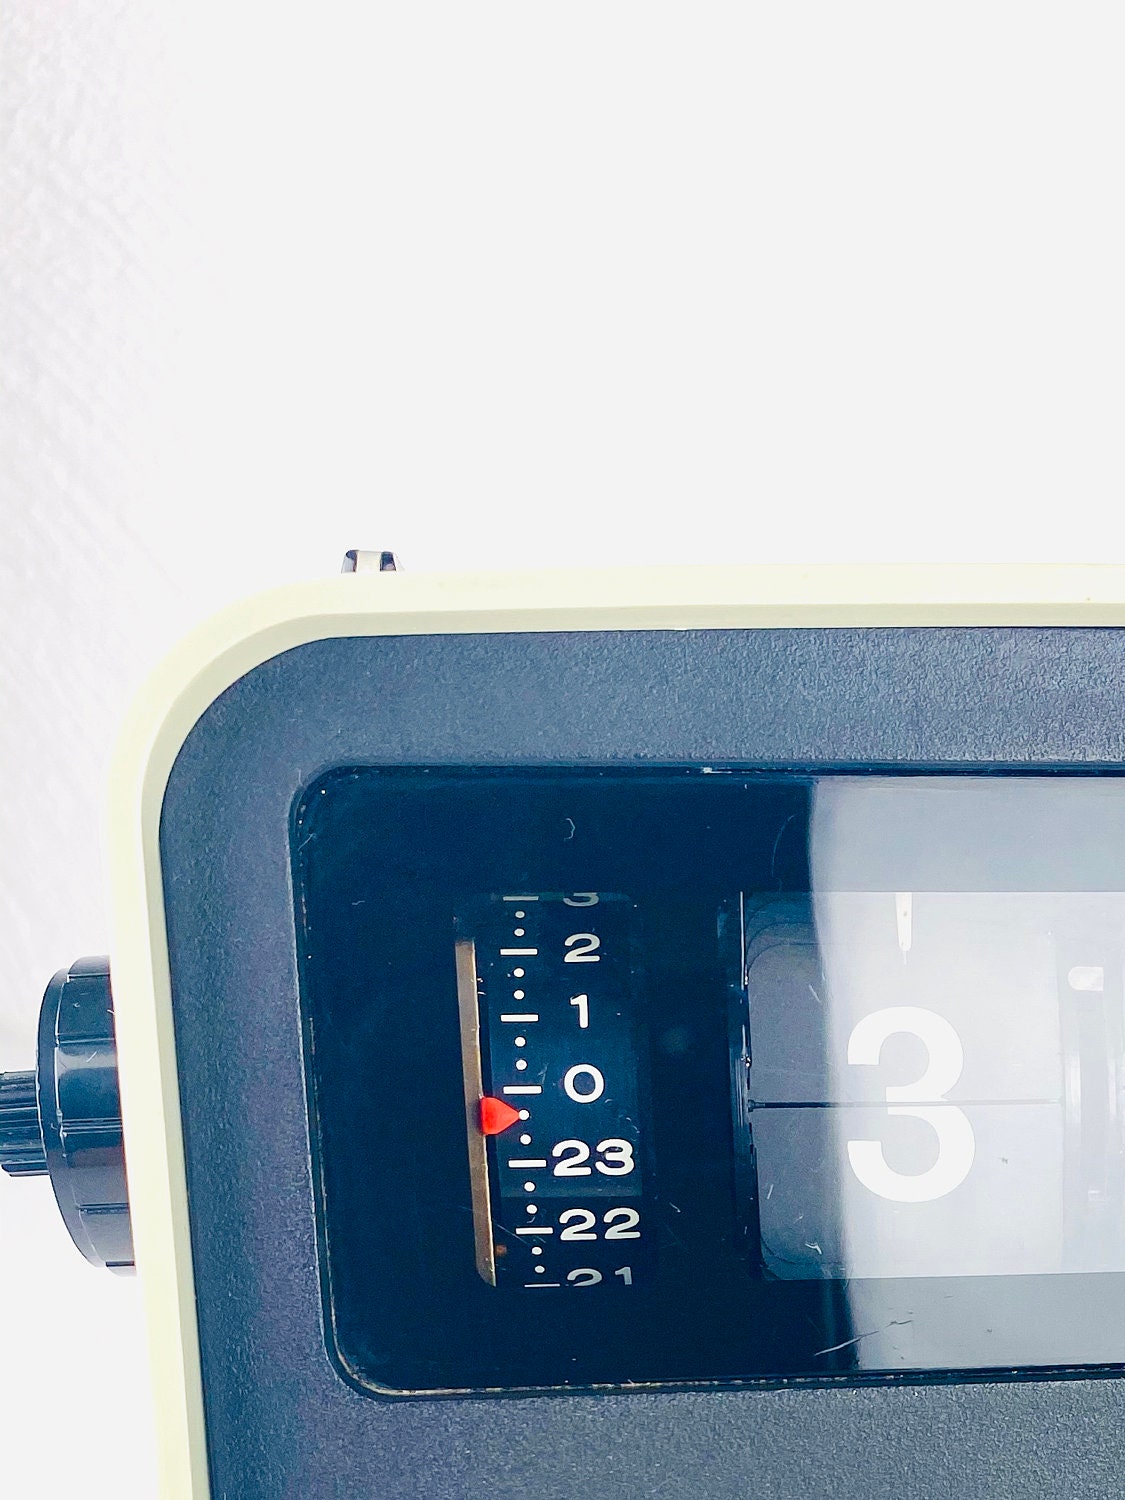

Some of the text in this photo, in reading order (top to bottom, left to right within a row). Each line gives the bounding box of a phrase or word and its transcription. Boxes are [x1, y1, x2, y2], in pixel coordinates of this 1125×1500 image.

[564, 933, 601, 963] 2
[570, 994, 589, 1028] 1
[563, 1063, 605, 1103] 0
[846, 1006, 976, 1203] 3
[551, 1138, 635, 1177] 23
[559, 1207, 641, 1241] 22
